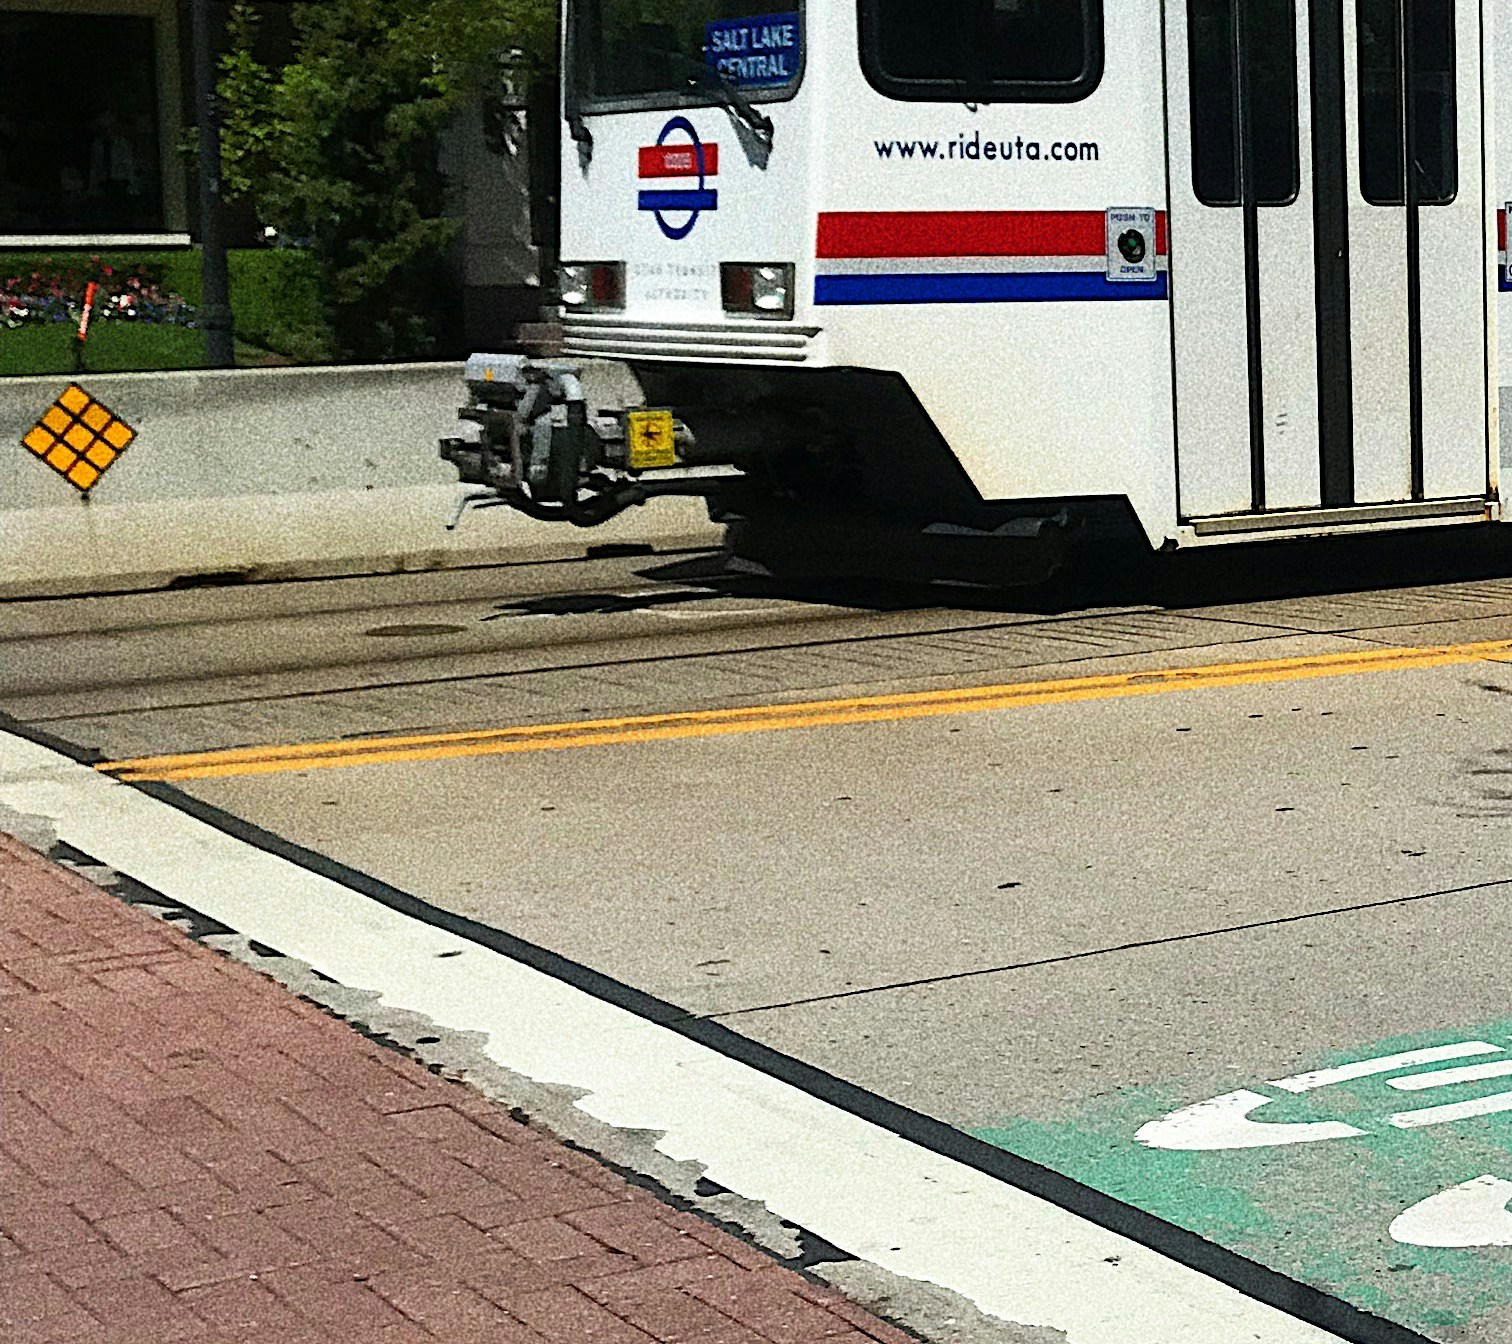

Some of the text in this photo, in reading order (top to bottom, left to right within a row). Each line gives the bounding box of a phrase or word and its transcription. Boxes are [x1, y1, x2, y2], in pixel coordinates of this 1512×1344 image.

[711, 24, 794, 52] SALT LAKE
[873, 130, 1099, 161] www.rideuta.com
